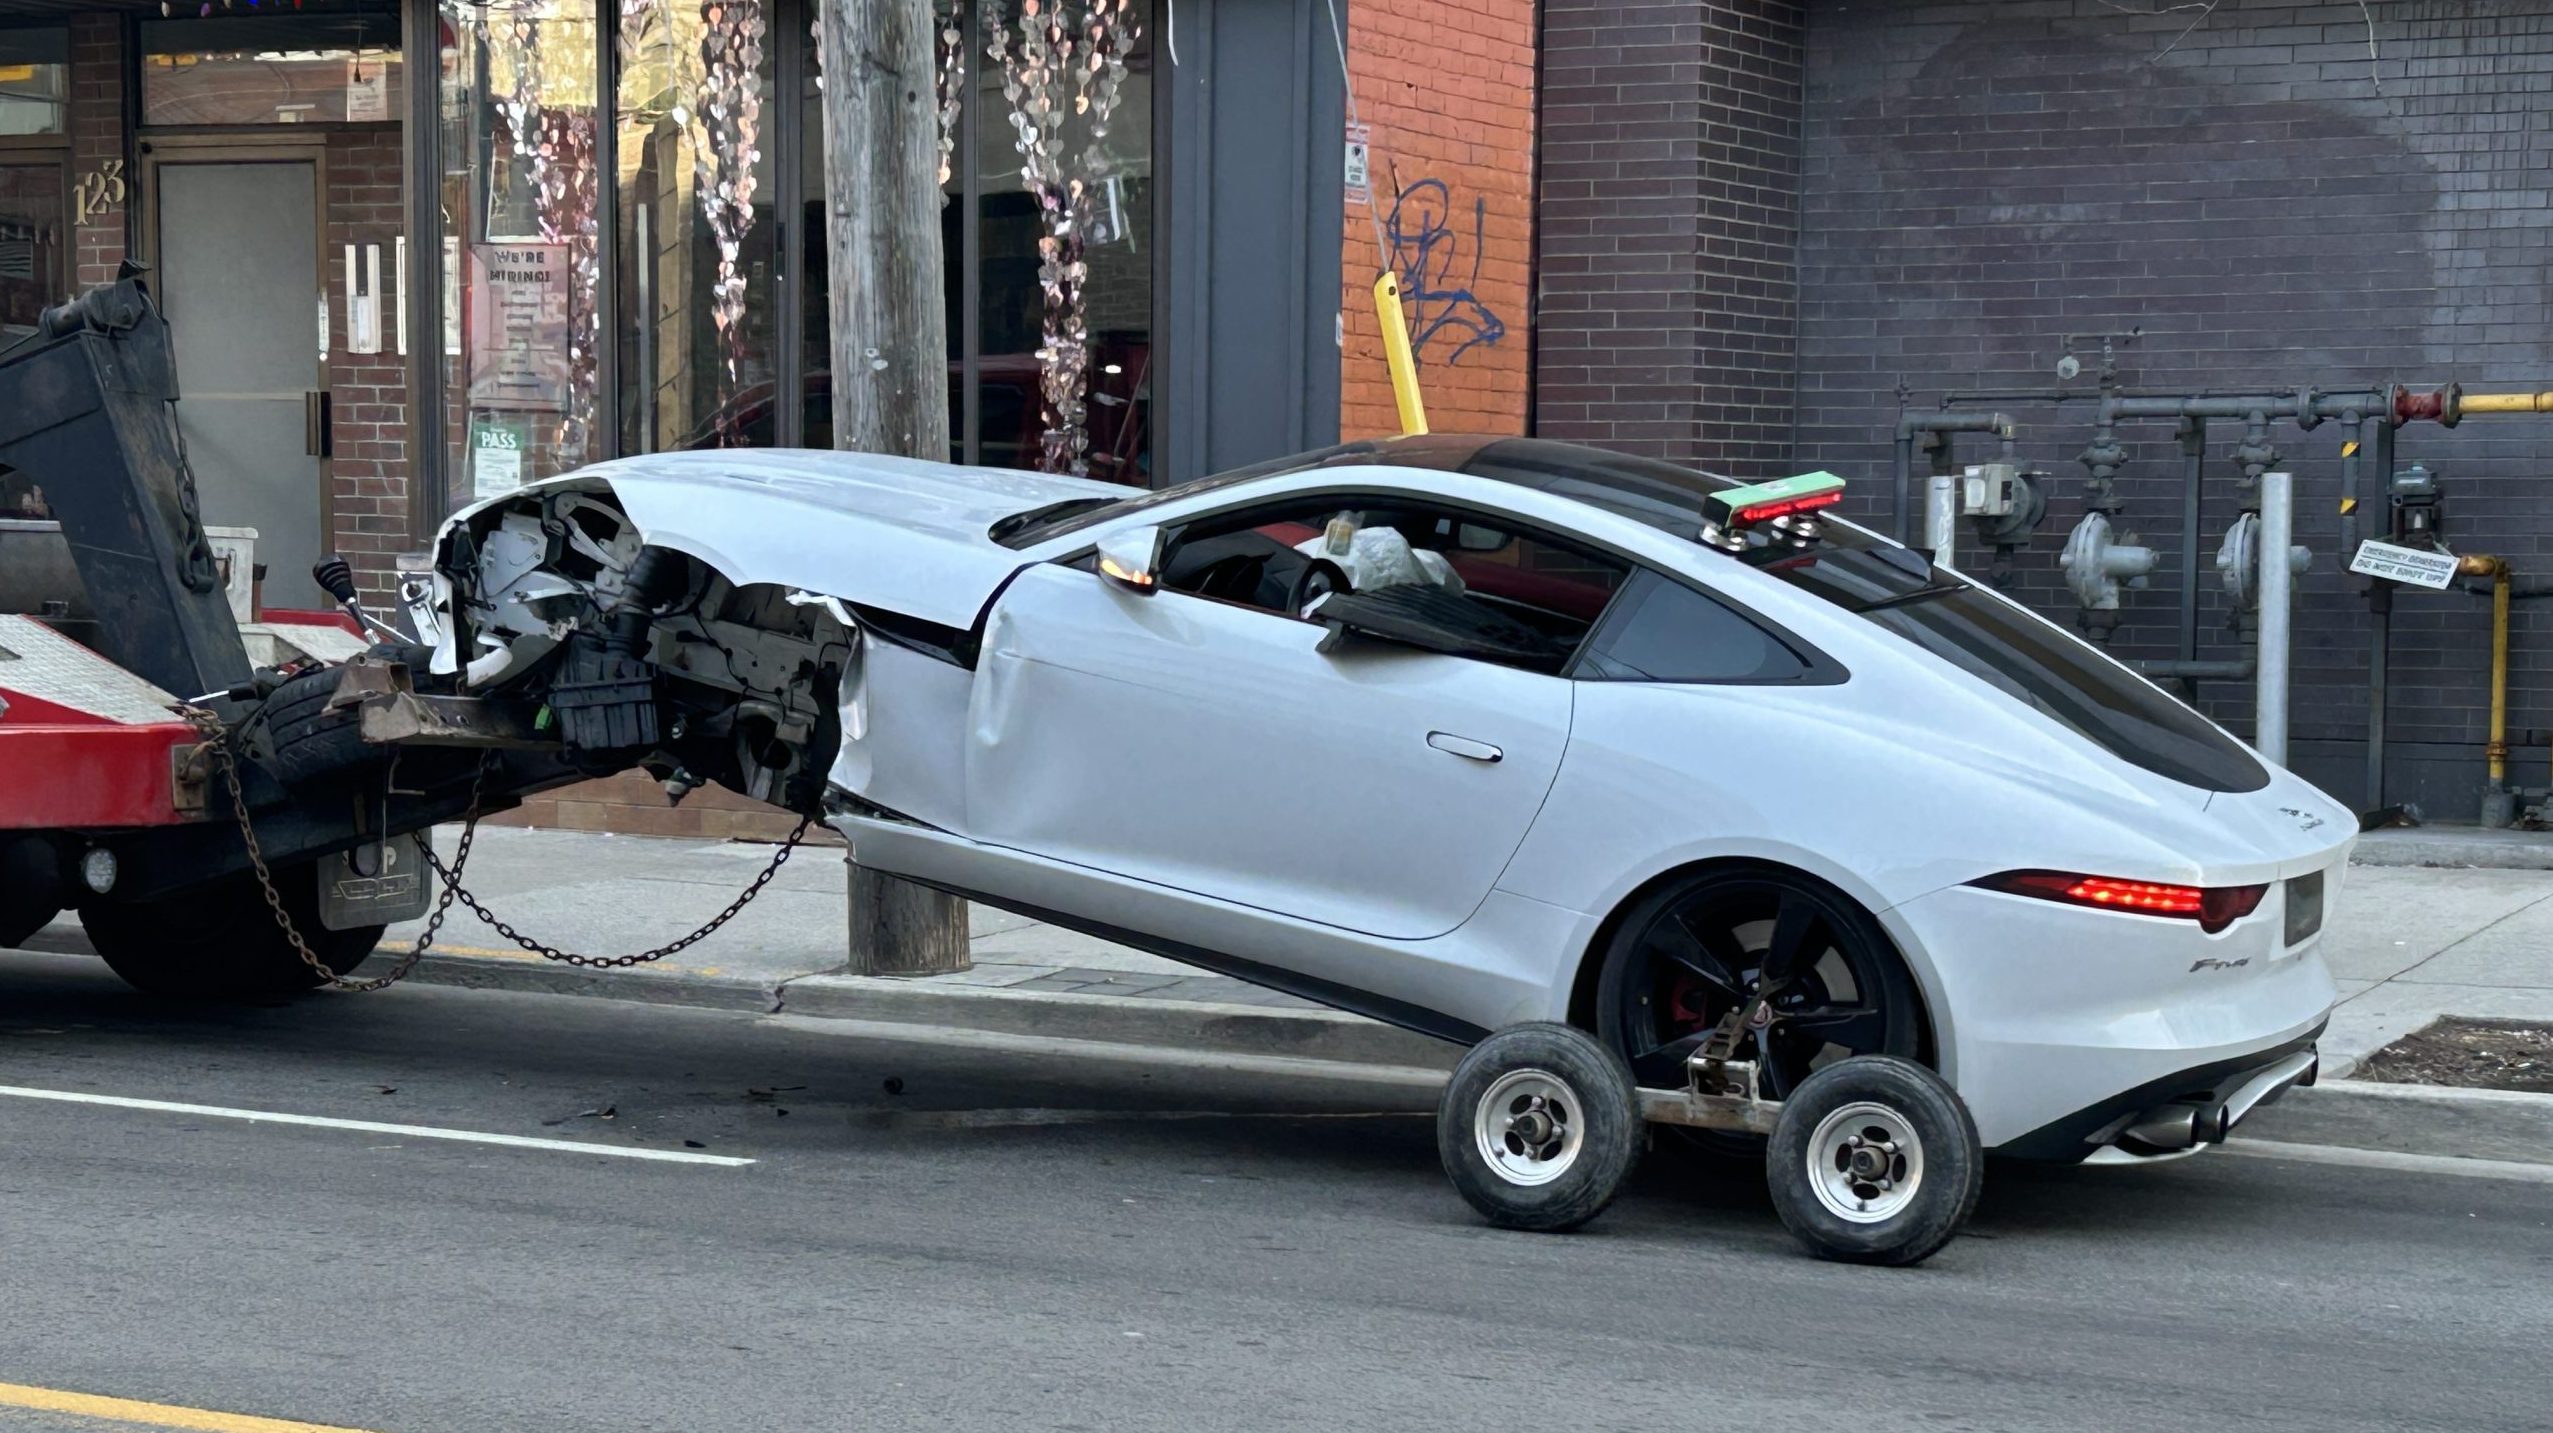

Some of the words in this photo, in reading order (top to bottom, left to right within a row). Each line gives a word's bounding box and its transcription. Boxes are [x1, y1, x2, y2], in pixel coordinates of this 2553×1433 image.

[73, 159, 125, 225] 123
[495, 251, 545, 263] WE'RE
[481, 431, 517, 449] PASS
